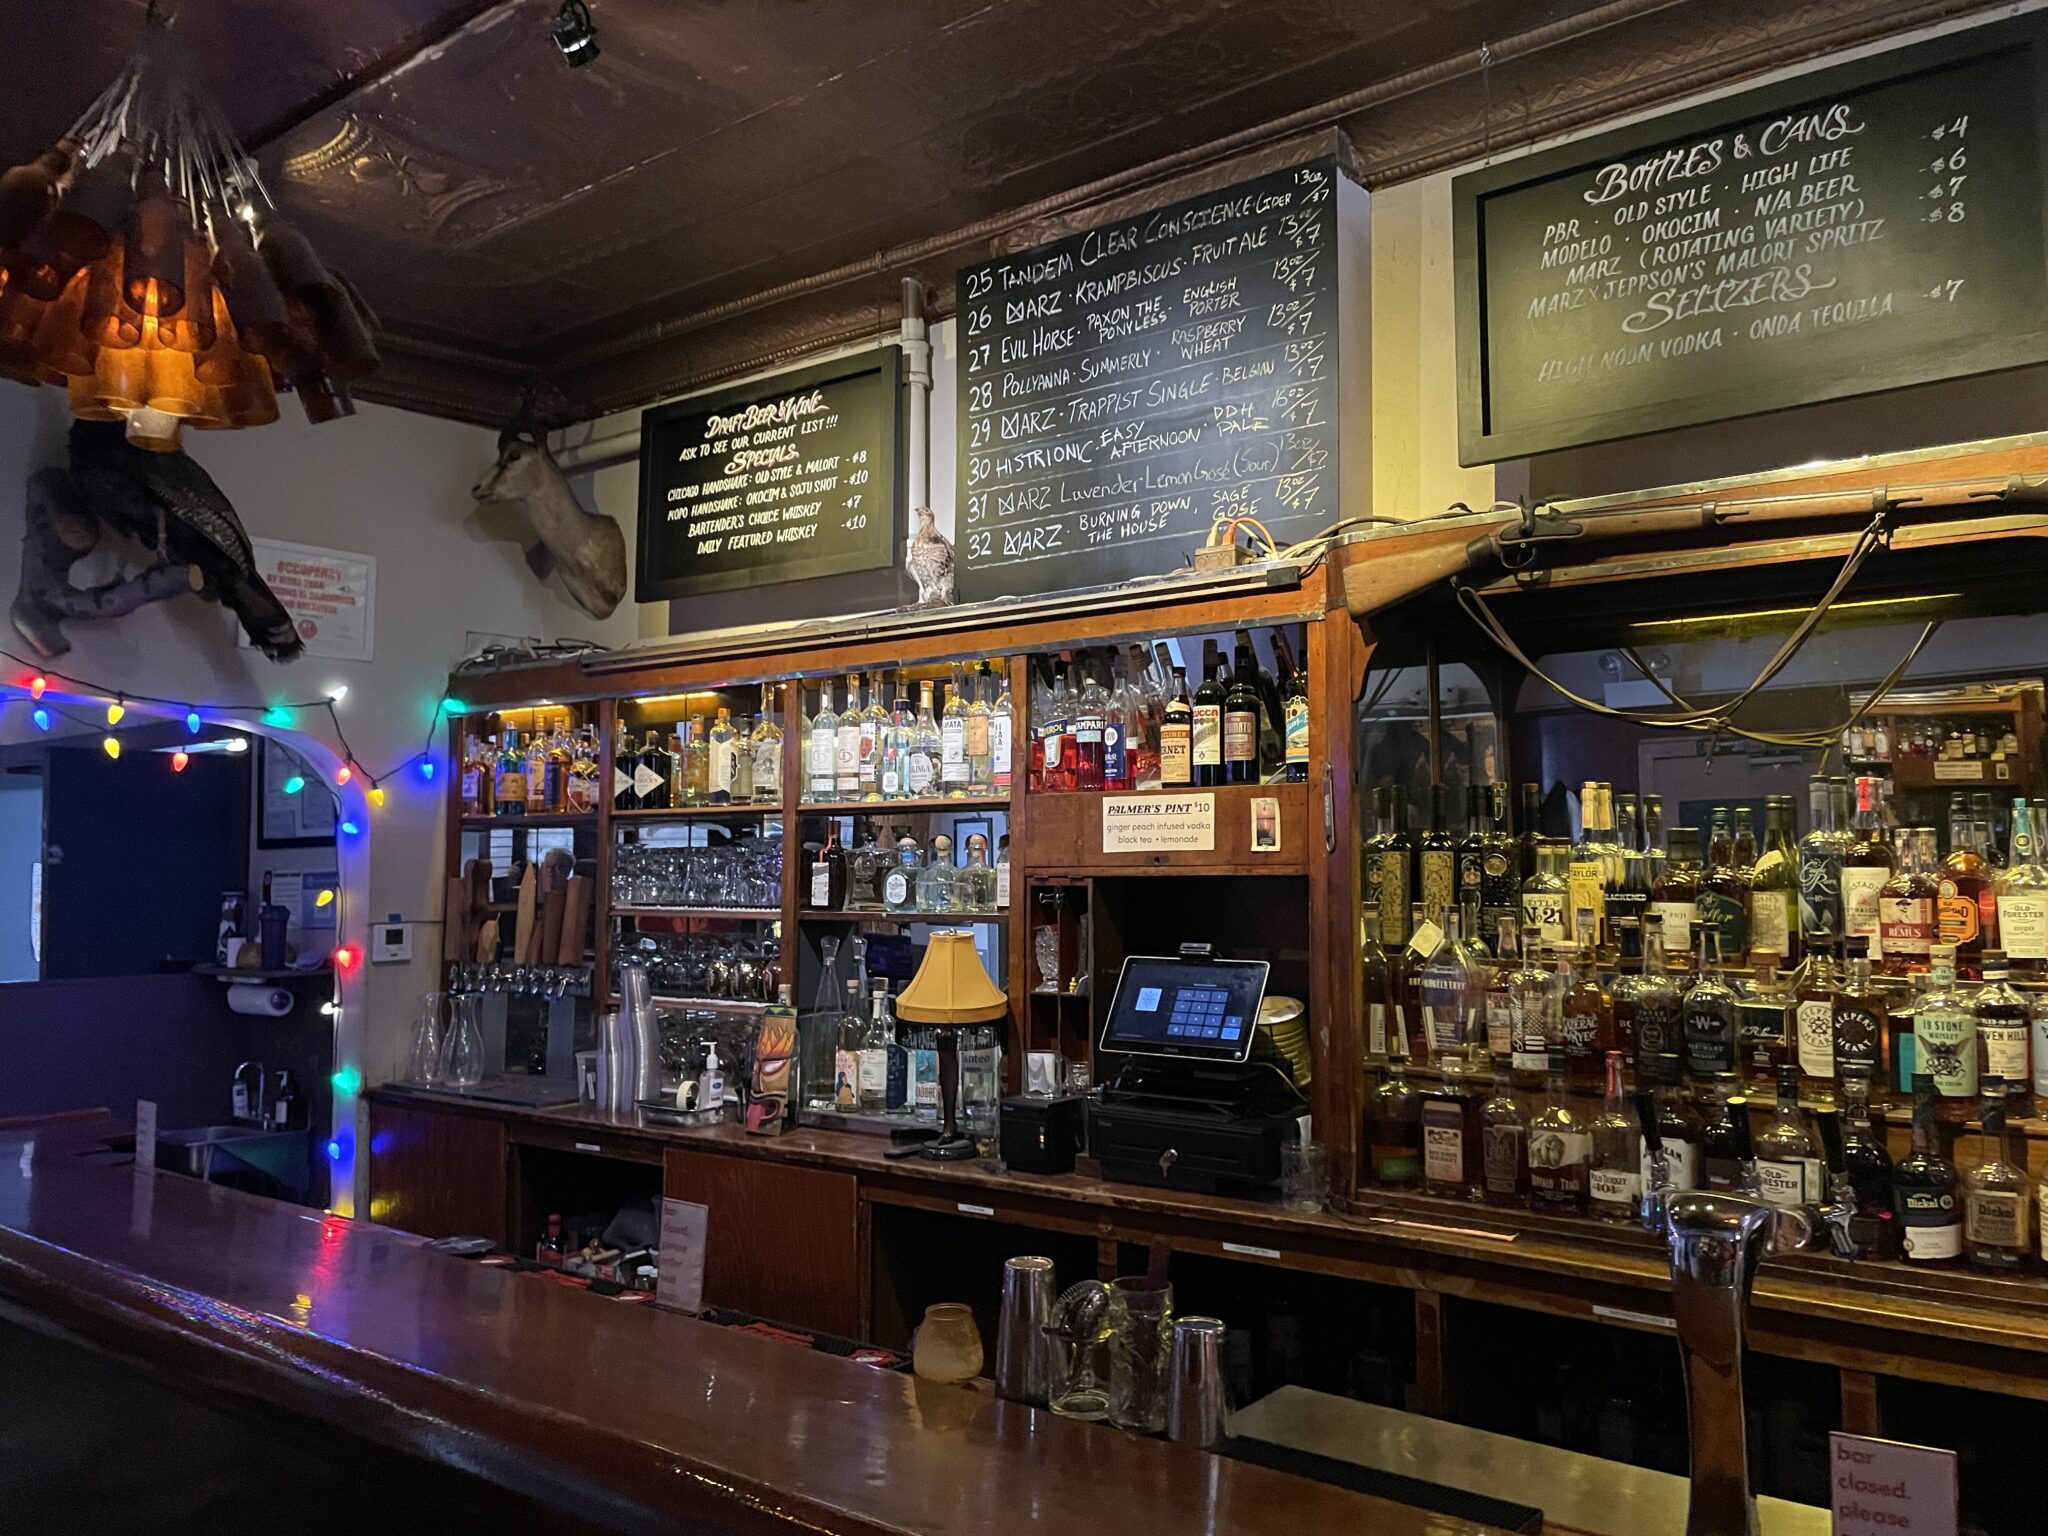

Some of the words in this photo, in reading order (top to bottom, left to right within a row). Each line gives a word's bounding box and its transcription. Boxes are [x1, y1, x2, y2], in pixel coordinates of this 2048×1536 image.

[1584, 140, 1724, 205] BOTTLES
[1733, 134, 1751, 160] &
[1760, 104, 1865, 156] CANS
[1544, 219, 1581, 245] PBR
[1614, 200, 1648, 226] OLD
[1654, 185, 1712, 218] STYLE
[1742, 161, 1798, 194] HIGH
[1809, 148, 1854, 175] LIFE
[1541, 236, 1612, 270] MODELO
[1642, 208, 1721, 245] OKOCIM
[1754, 189, 1792, 218] N/A
[1796, 175, 1860, 208] BEER
[1566, 257, 1623, 287] MARZ
[1639, 227, 1755, 271] (ROTATING
[1765, 199, 1865, 240] VARIETY)
[967, 270, 992, 299] 25
[999, 254, 1073, 291] TANDEM
[1080, 228, 1137, 266] CLEAR
[968, 306, 992, 336] 26
[1193, 237, 1237, 266] FRUIT
[1238, 226, 1268, 248] ALE
[1527, 287, 1587, 320] MARZ
[1602, 260, 1704, 302] JEPPSON'S
[1716, 238, 1796, 276] MALORT
[1806, 219, 1885, 253] SPRITZ
[1099, 312, 1167, 344] PONYLESS
[1189, 291, 1241, 317] PORTER
[1622, 263, 1837, 335] SELTZERS
[969, 345, 991, 372] 27
[1002, 334, 1028, 364] EVIL
[1033, 325, 1076, 359] HORSE
[1088, 308, 1131, 331] PAXON
[1136, 297, 1162, 316] THE
[1184, 277, 1236, 304] ENGLISH
[1181, 335, 1234, 360] WHEAT
[1660, 328, 1722, 359] VODKA
[1749, 314, 1801, 340] ONDA
[1810, 294, 1894, 326] TEQUILA
[969, 384, 992, 412] 28
[1002, 371, 1070, 398] POLLYANNA
[1081, 349, 1150, 380] SUMMERLY
[1171, 316, 1246, 345] RASPBERRY
[704, 414, 746, 439] DRAFT
[743, 404, 779, 430] BEER
[786, 389, 830, 422] WINE
[971, 420, 991, 448] 29
[1068, 390, 1140, 424] TRAPPIST
[1147, 373, 1210, 407] SINGLE
[1223, 360, 1276, 386] BELGIAN
[679, 446, 697, 461] ASK
[700, 443, 710, 456] TO
[713, 439, 728, 454] SEE
[732, 435, 749, 450] OUR
[754, 425, 796, 446] CURRENT
[724, 443, 799, 474] SPECIALS
[968, 459, 991, 486] 30
[996, 442, 1093, 474] HISTRIONIC
[1100, 421, 1144, 448] EASY
[1214, 403, 1255, 420] DDH
[1110, 428, 1202, 459] AFTERNOON
[1218, 417, 1269, 437] PALE
[667, 484, 699, 501] CHICAGO
[755, 471, 769, 484] OLD
[770, 465, 792, 482] STYLE
[796, 465, 802, 476] &
[806, 456, 839, 474] MALORT
[746, 490, 780, 506] OKOCIM
[781, 486, 787, 499] &
[790, 481, 813, 497] SOJU
[813, 476, 838, 493] SHOT
[968, 498, 988, 522] 31
[1060, 472, 1141, 503] Lavender
[1144, 465, 1192, 489] Lemon
[688, 514, 744, 538] BARTENDER'S
[749, 508, 779, 526] CHOICE
[783, 502, 822, 520] WHISKEY
[697, 537, 722, 555] DAILY
[728, 529, 772, 551] FEATURED
[777, 524, 817, 543] WHISKEY
[968, 533, 991, 559] 32
[1080, 501, 1141, 530] BURNING
[1211, 485, 1252, 504] SAGE
[1088, 528, 1113, 544] THE
[1120, 513, 1167, 537] HOUSE
[1213, 499, 1262, 520] GOSE
[1107, 823, 1130, 833] ginger
[1132, 822, 1155, 832] peach
[1157, 822, 1185, 830] infused
[1187, 822, 1211, 830] vodka
[1108, 805, 1161, 814] PALMER'S
[1165, 804, 1192, 813] PINT
[1194, 802, 1210, 812] $10
[1118, 835, 1137, 843] black
[1160, 835, 1199, 843] lemonade
[1888, 927, 1921, 938] REMUS
[1835, 1012, 1875, 1031] KEEPER'S
[1836, 1038, 1872, 1052] HEART
[1935, 1022, 1964, 1032] STONE
